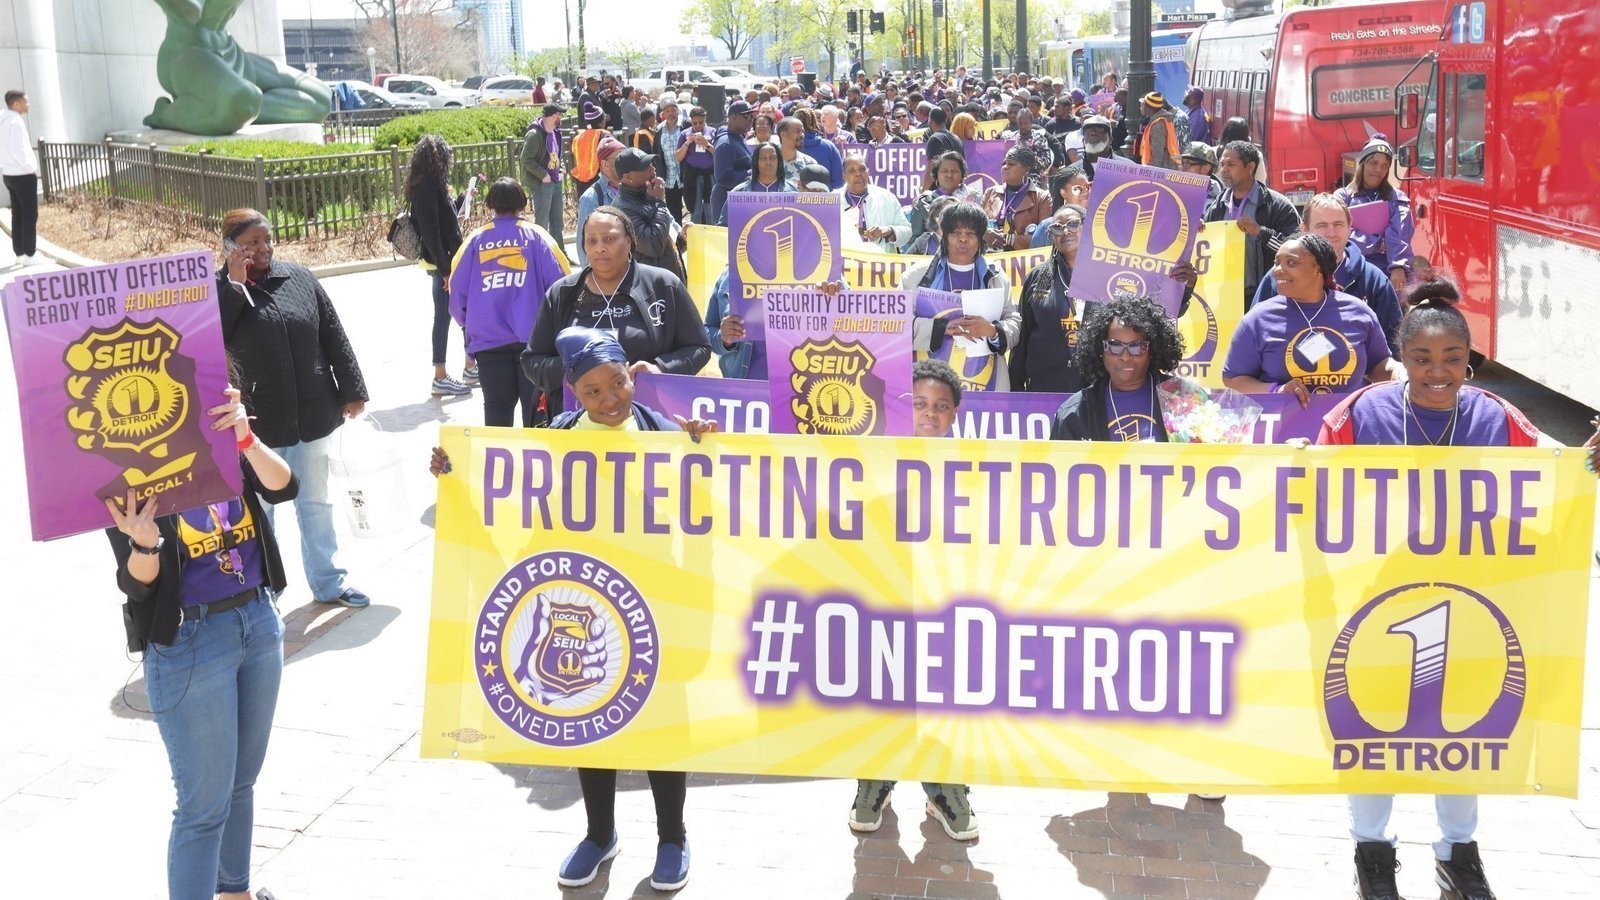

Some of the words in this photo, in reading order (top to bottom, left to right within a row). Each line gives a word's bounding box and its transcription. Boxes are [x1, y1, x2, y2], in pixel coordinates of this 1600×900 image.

[1331, 29, 1354, 40] Fresh
[1356, 28, 1376, 38] Eats
[1379, 29, 1390, 37] on
[1392, 26, 1407, 35] the
[1409, 23, 1442, 34] Streets
[1330, 87, 1390, 104] CONCRETE
[1098, 161, 1129, 173] TOGETHER
[1129, 167, 1137, 175] WE
[1140, 169, 1153, 179] RISE
[1154, 171, 1165, 179] FOR
[886, 174, 920, 199] FOR
[729, 195, 757, 203] TOGETHER
[758, 195, 768, 203] WE
[769, 195, 781, 203] RISE
[783, 195, 795, 203] FOR
[479, 239, 518, 250] LOCAL
[1092, 247, 1175, 275] DETROIT
[23, 268, 118, 304] SECURITY
[126, 256, 208, 289] OFFICERS
[482, 272, 527, 292] SEIU
[27, 302, 79, 326] READY
[88, 296, 117, 318] FOR
[767, 293, 832, 313] SECURITY
[838, 294, 906, 314] OFFICERS
[769, 315, 802, 331] READY
[807, 316, 827, 331] FOR
[93, 337, 162, 370] SEIU
[808, 355, 860, 375] SEIU
[1303, 374, 1351, 386] ETROIT
[111, 412, 158, 428] DETROIT
[819, 416, 852, 424] DETROIT
[952, 410, 1051, 440] WHO
[136, 477, 183, 501] LOCAL
[484, 447, 864, 541] PROTECTING
[895, 459, 1242, 550] DETROIT'S
[1275, 467, 1541, 556] FUTURE
[480, 577, 522, 654] STAND
[525, 557, 572, 582] FOR
[580, 562, 653, 665] SECURITY
[554, 613, 580, 621] LOCAL
[552, 637, 586, 650] SEIU
[489, 682, 640, 741] #ONEDETROIT
[1333, 742, 1509, 771] DETROIT
